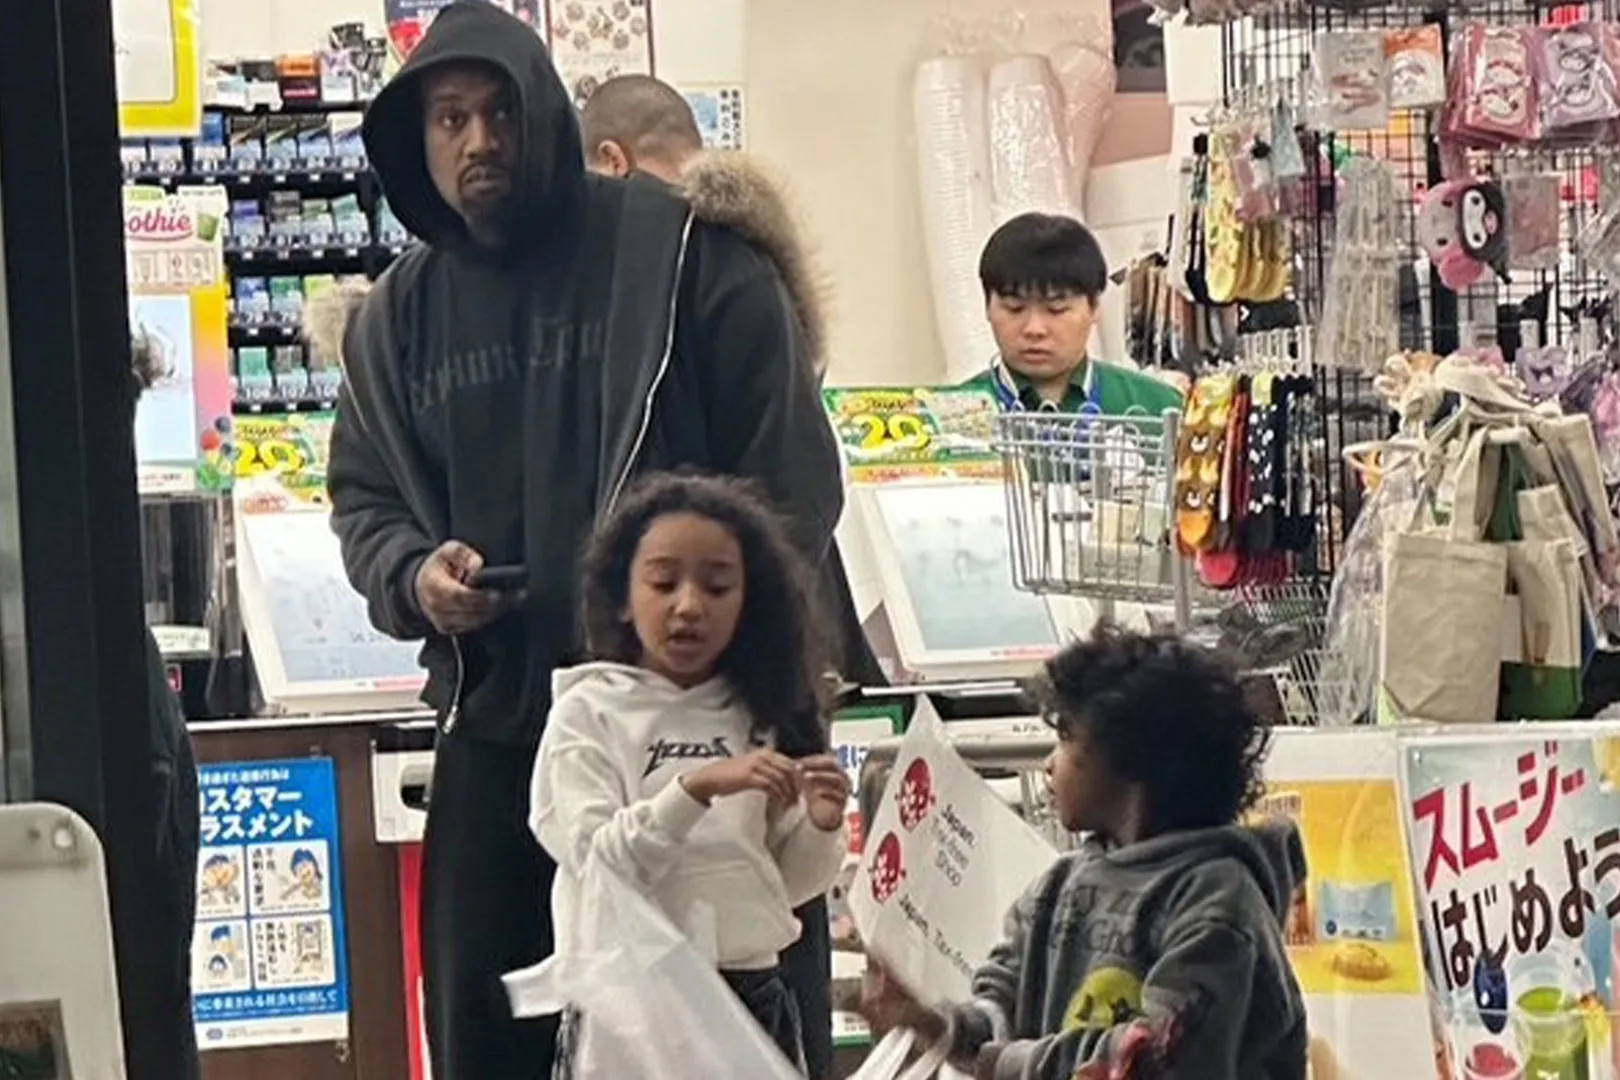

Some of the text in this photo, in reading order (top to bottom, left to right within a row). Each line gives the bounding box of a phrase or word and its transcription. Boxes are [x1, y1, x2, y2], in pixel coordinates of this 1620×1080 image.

[200, 808, 314, 842] ラスメント
[1413, 739, 1585, 893] スムージー
[1431, 828, 1620, 991] はじめよう
